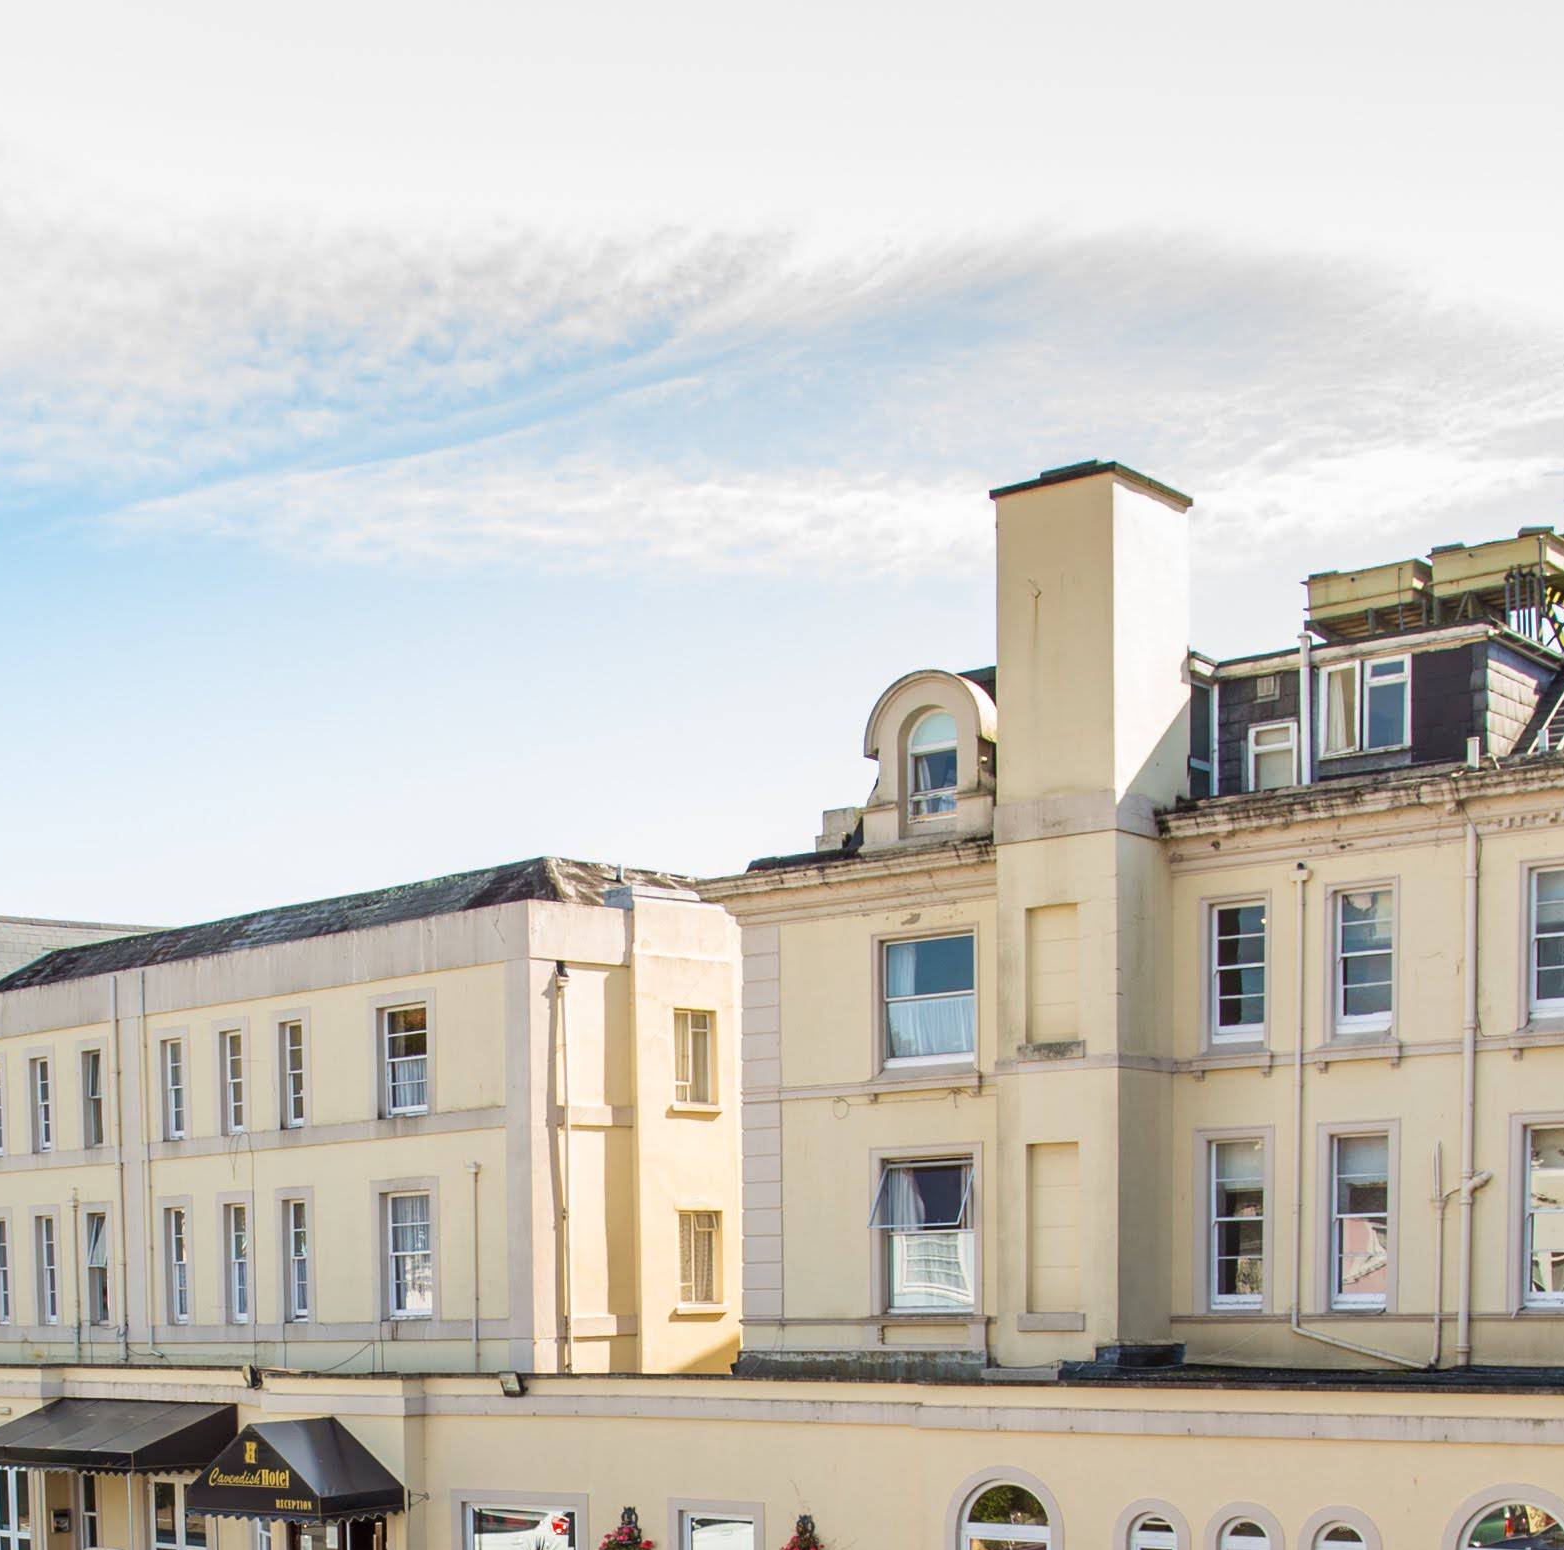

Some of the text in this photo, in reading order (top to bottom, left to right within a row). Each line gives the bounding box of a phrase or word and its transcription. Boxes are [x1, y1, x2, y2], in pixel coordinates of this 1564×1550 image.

[208, 1467, 290, 1488] Cavendish Hotel
[275, 1498, 313, 1510] RECEPTION
